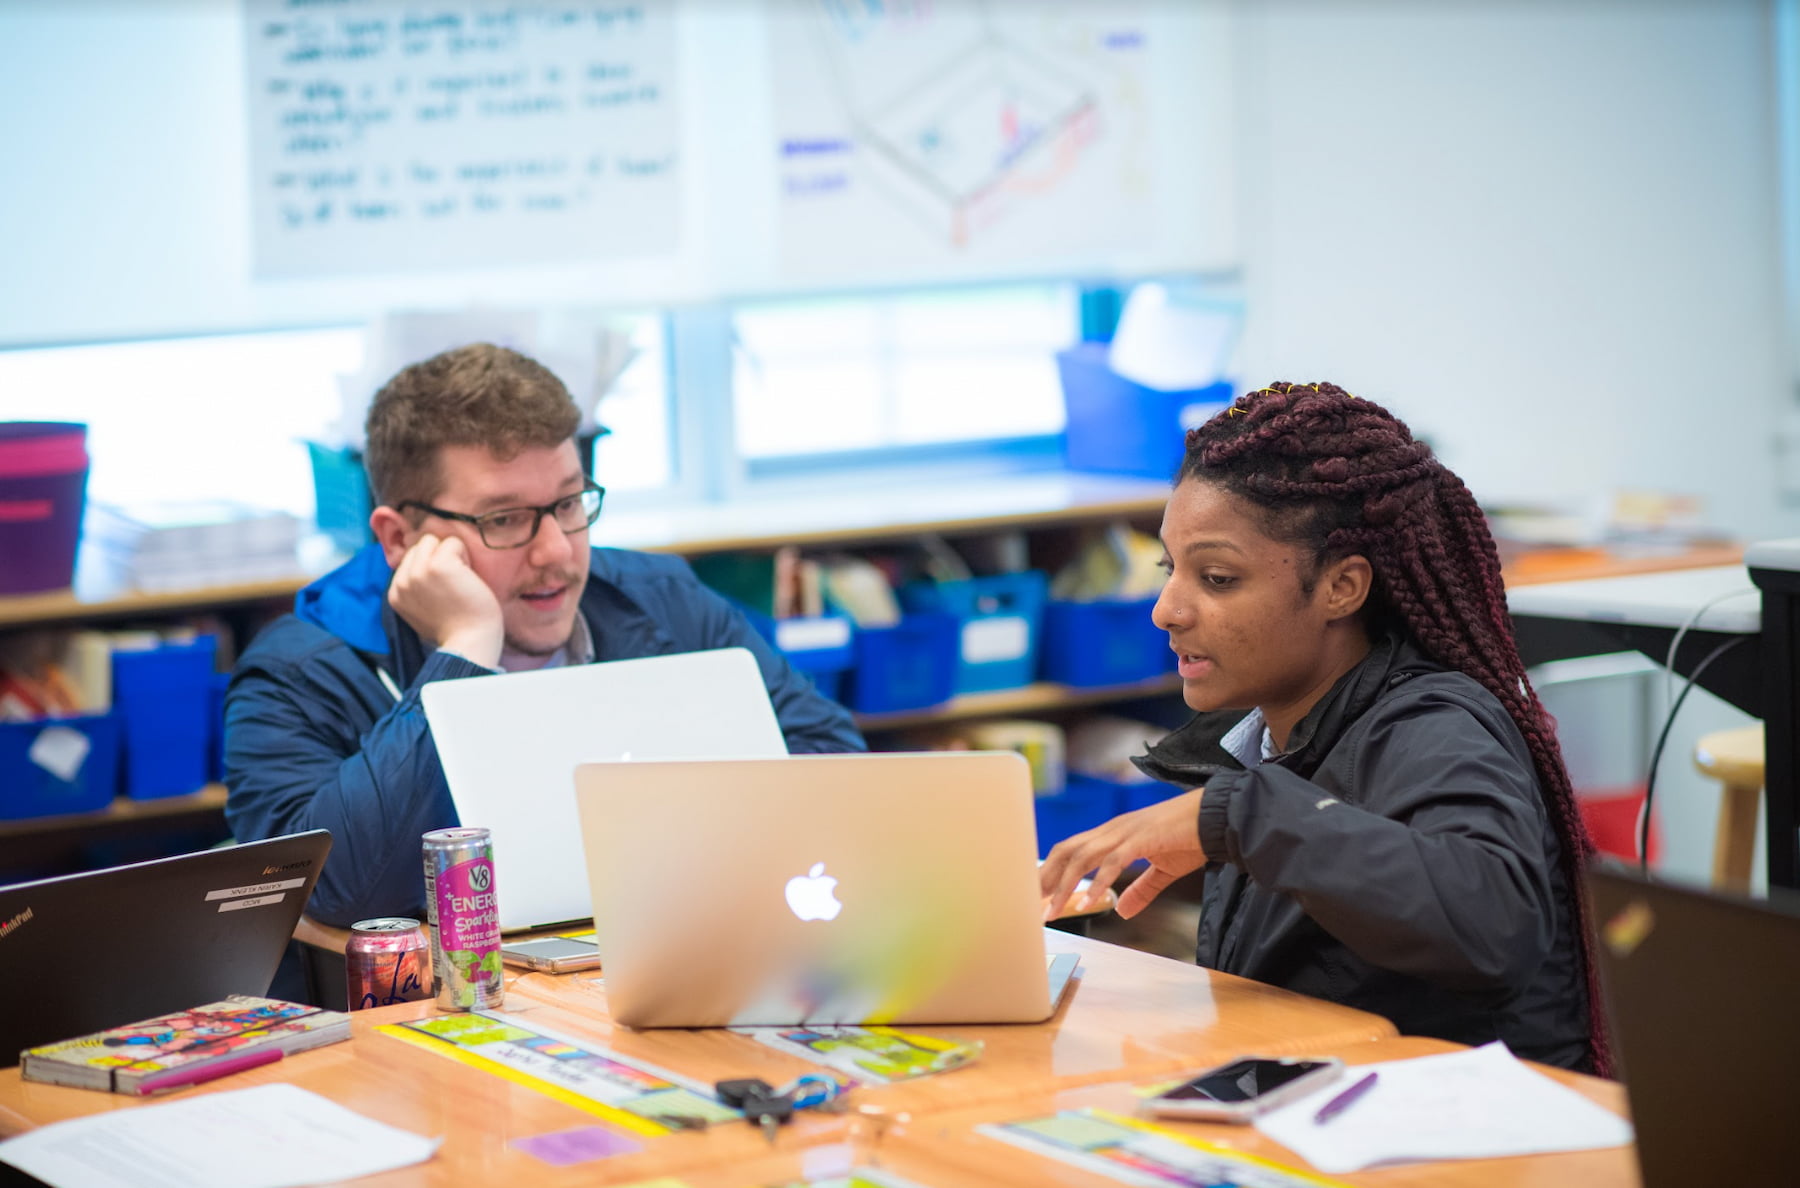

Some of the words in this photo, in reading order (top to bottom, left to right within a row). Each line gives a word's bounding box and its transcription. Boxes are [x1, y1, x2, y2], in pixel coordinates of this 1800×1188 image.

[469, 864, 489, 888] V8
[0, 906, 34, 938] hinkPad
[458, 931, 485, 942] WHITE
